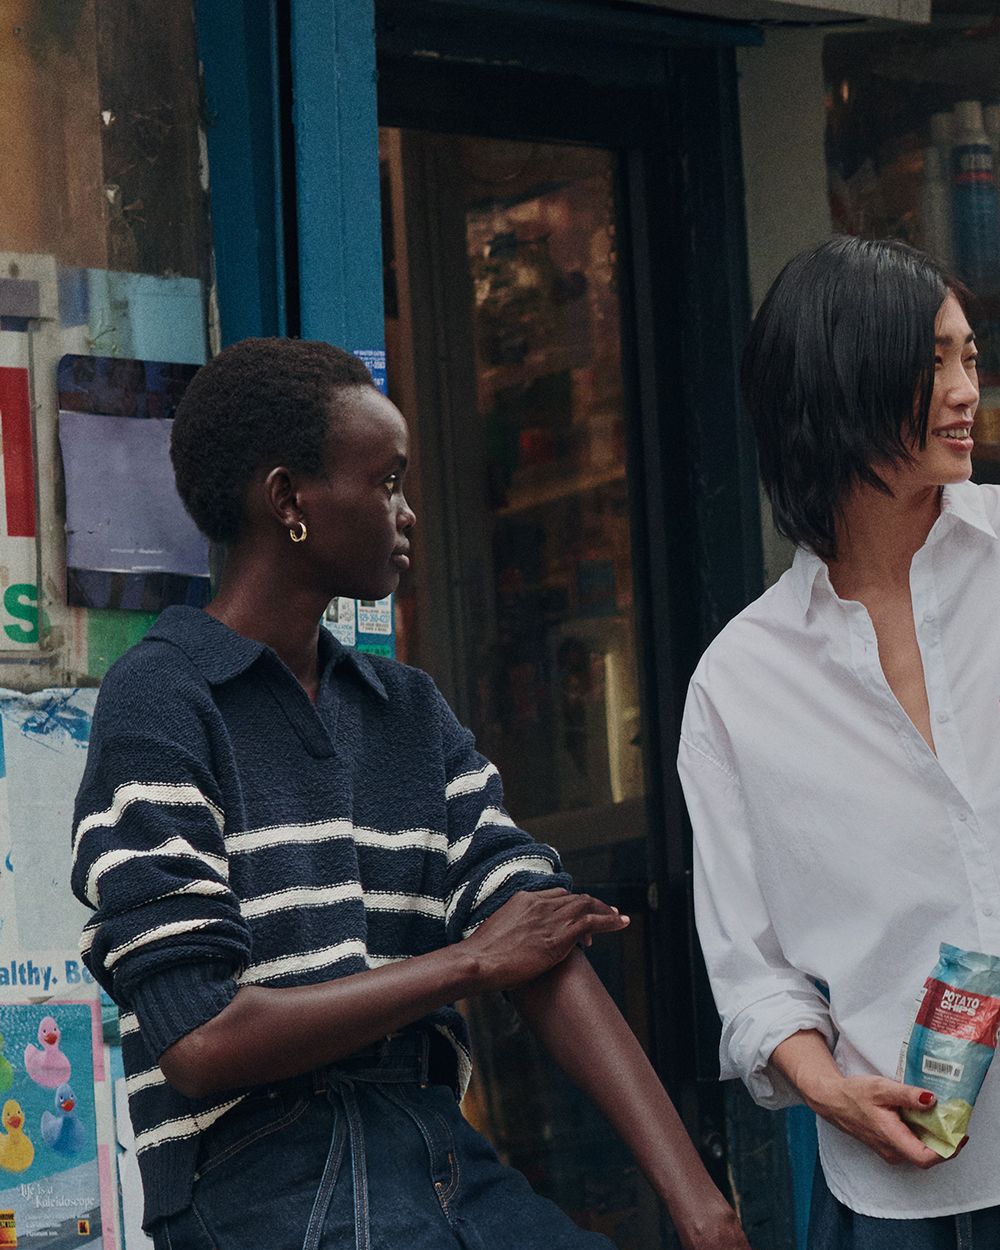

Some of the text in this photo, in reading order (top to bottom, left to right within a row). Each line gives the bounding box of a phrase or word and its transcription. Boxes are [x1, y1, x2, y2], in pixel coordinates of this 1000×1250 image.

[942, 988, 980, 1010] POTATO
[940, 1000, 977, 1017] CHIPS
[34, 1195, 95, 1209] Kaleidoscope
